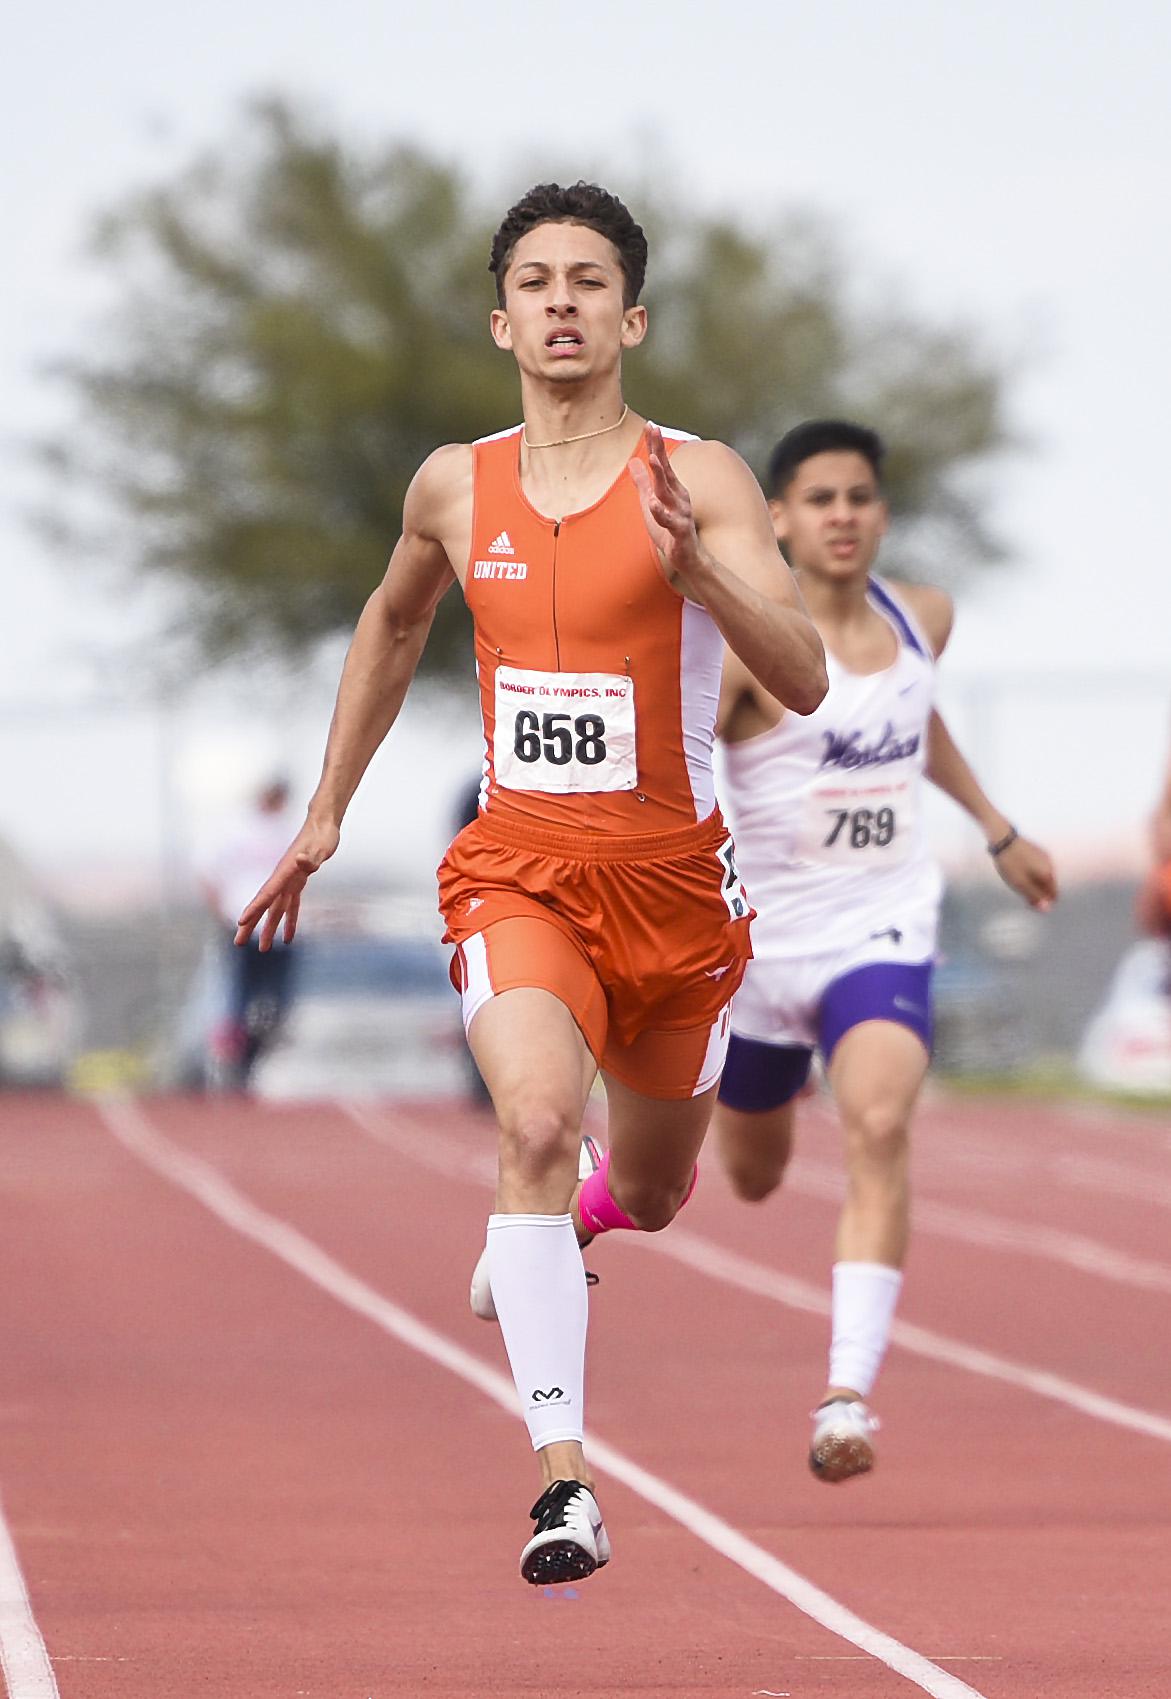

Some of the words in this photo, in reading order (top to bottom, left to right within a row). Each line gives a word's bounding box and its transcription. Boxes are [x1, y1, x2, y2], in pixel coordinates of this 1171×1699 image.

[488, 546, 514, 554] adidas
[473, 560, 527, 579] UNITED
[500, 681, 535, 695] BORDER
[539, 687, 601, 698] OLYMPICS,
[605, 688, 627, 697] INC
[514, 710, 607, 765] 658
[823, 806, 896, 849] 769
